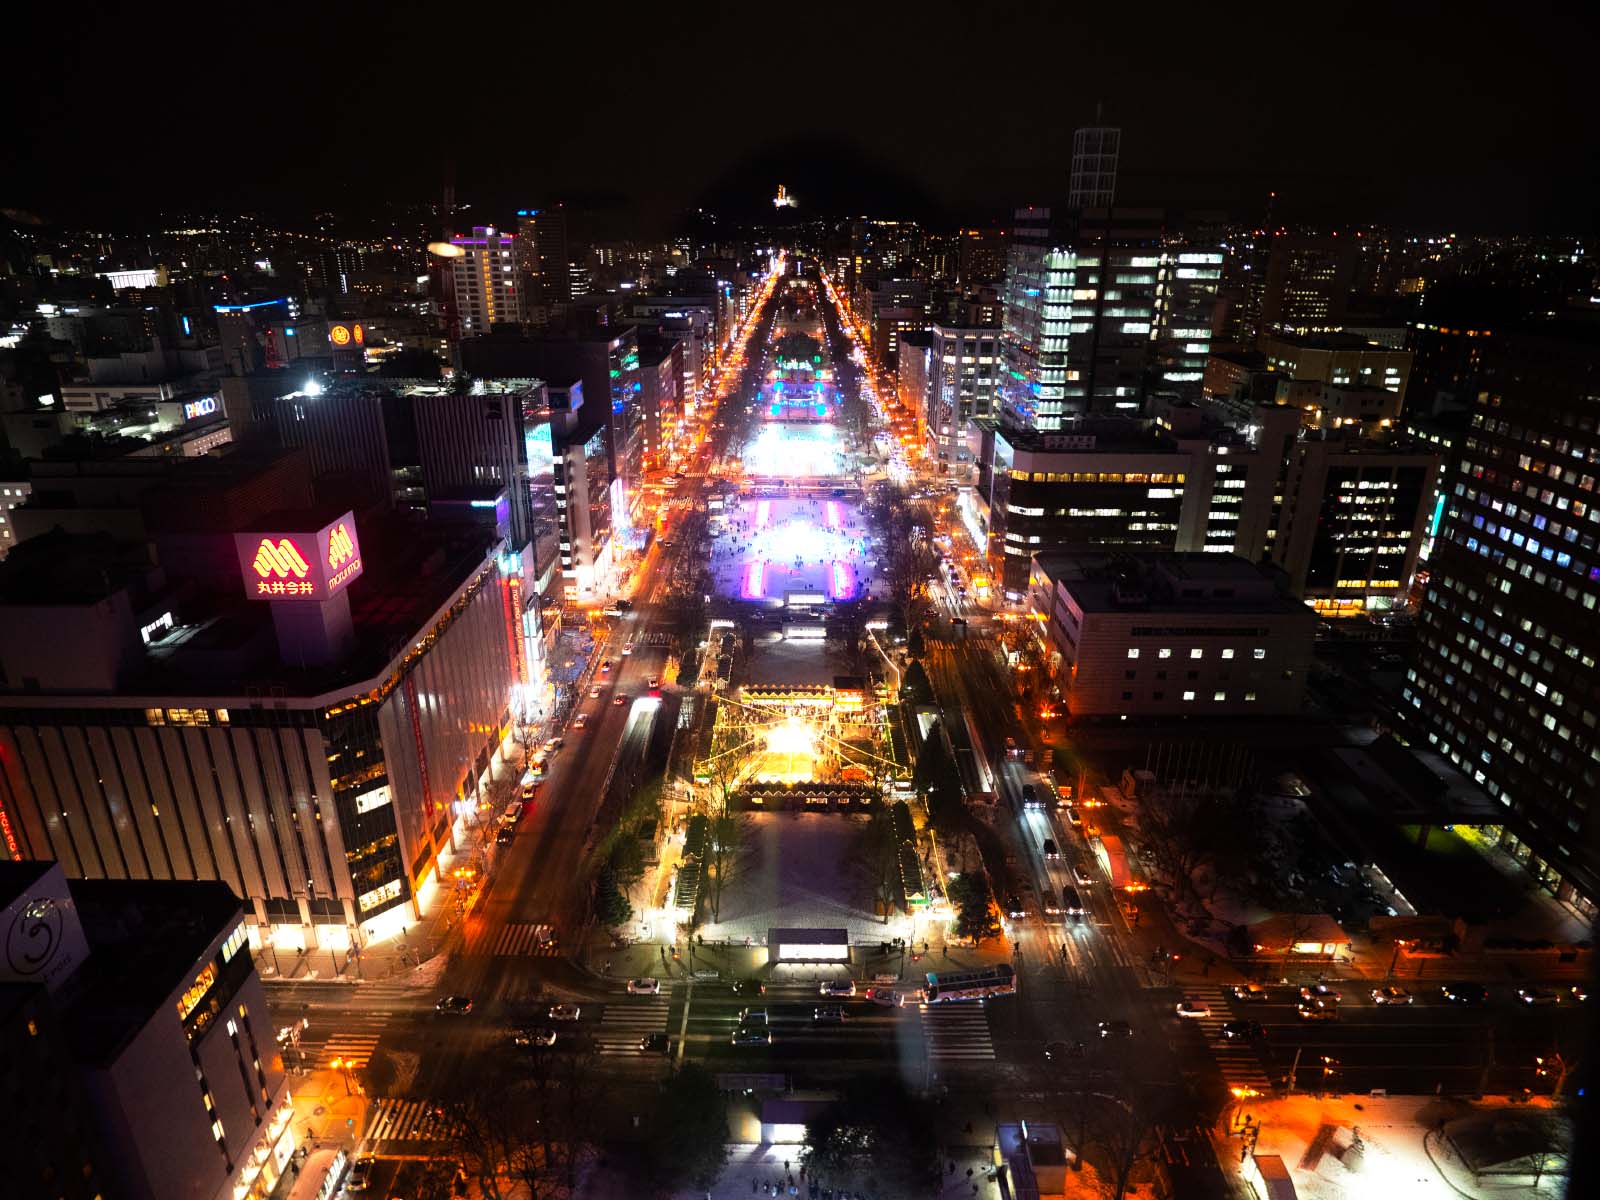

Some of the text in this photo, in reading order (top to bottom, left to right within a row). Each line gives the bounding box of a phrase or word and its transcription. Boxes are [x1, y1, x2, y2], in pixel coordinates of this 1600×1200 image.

[184, 397, 215, 419] PARCO
[257, 581, 314, 595] 丸井今井
